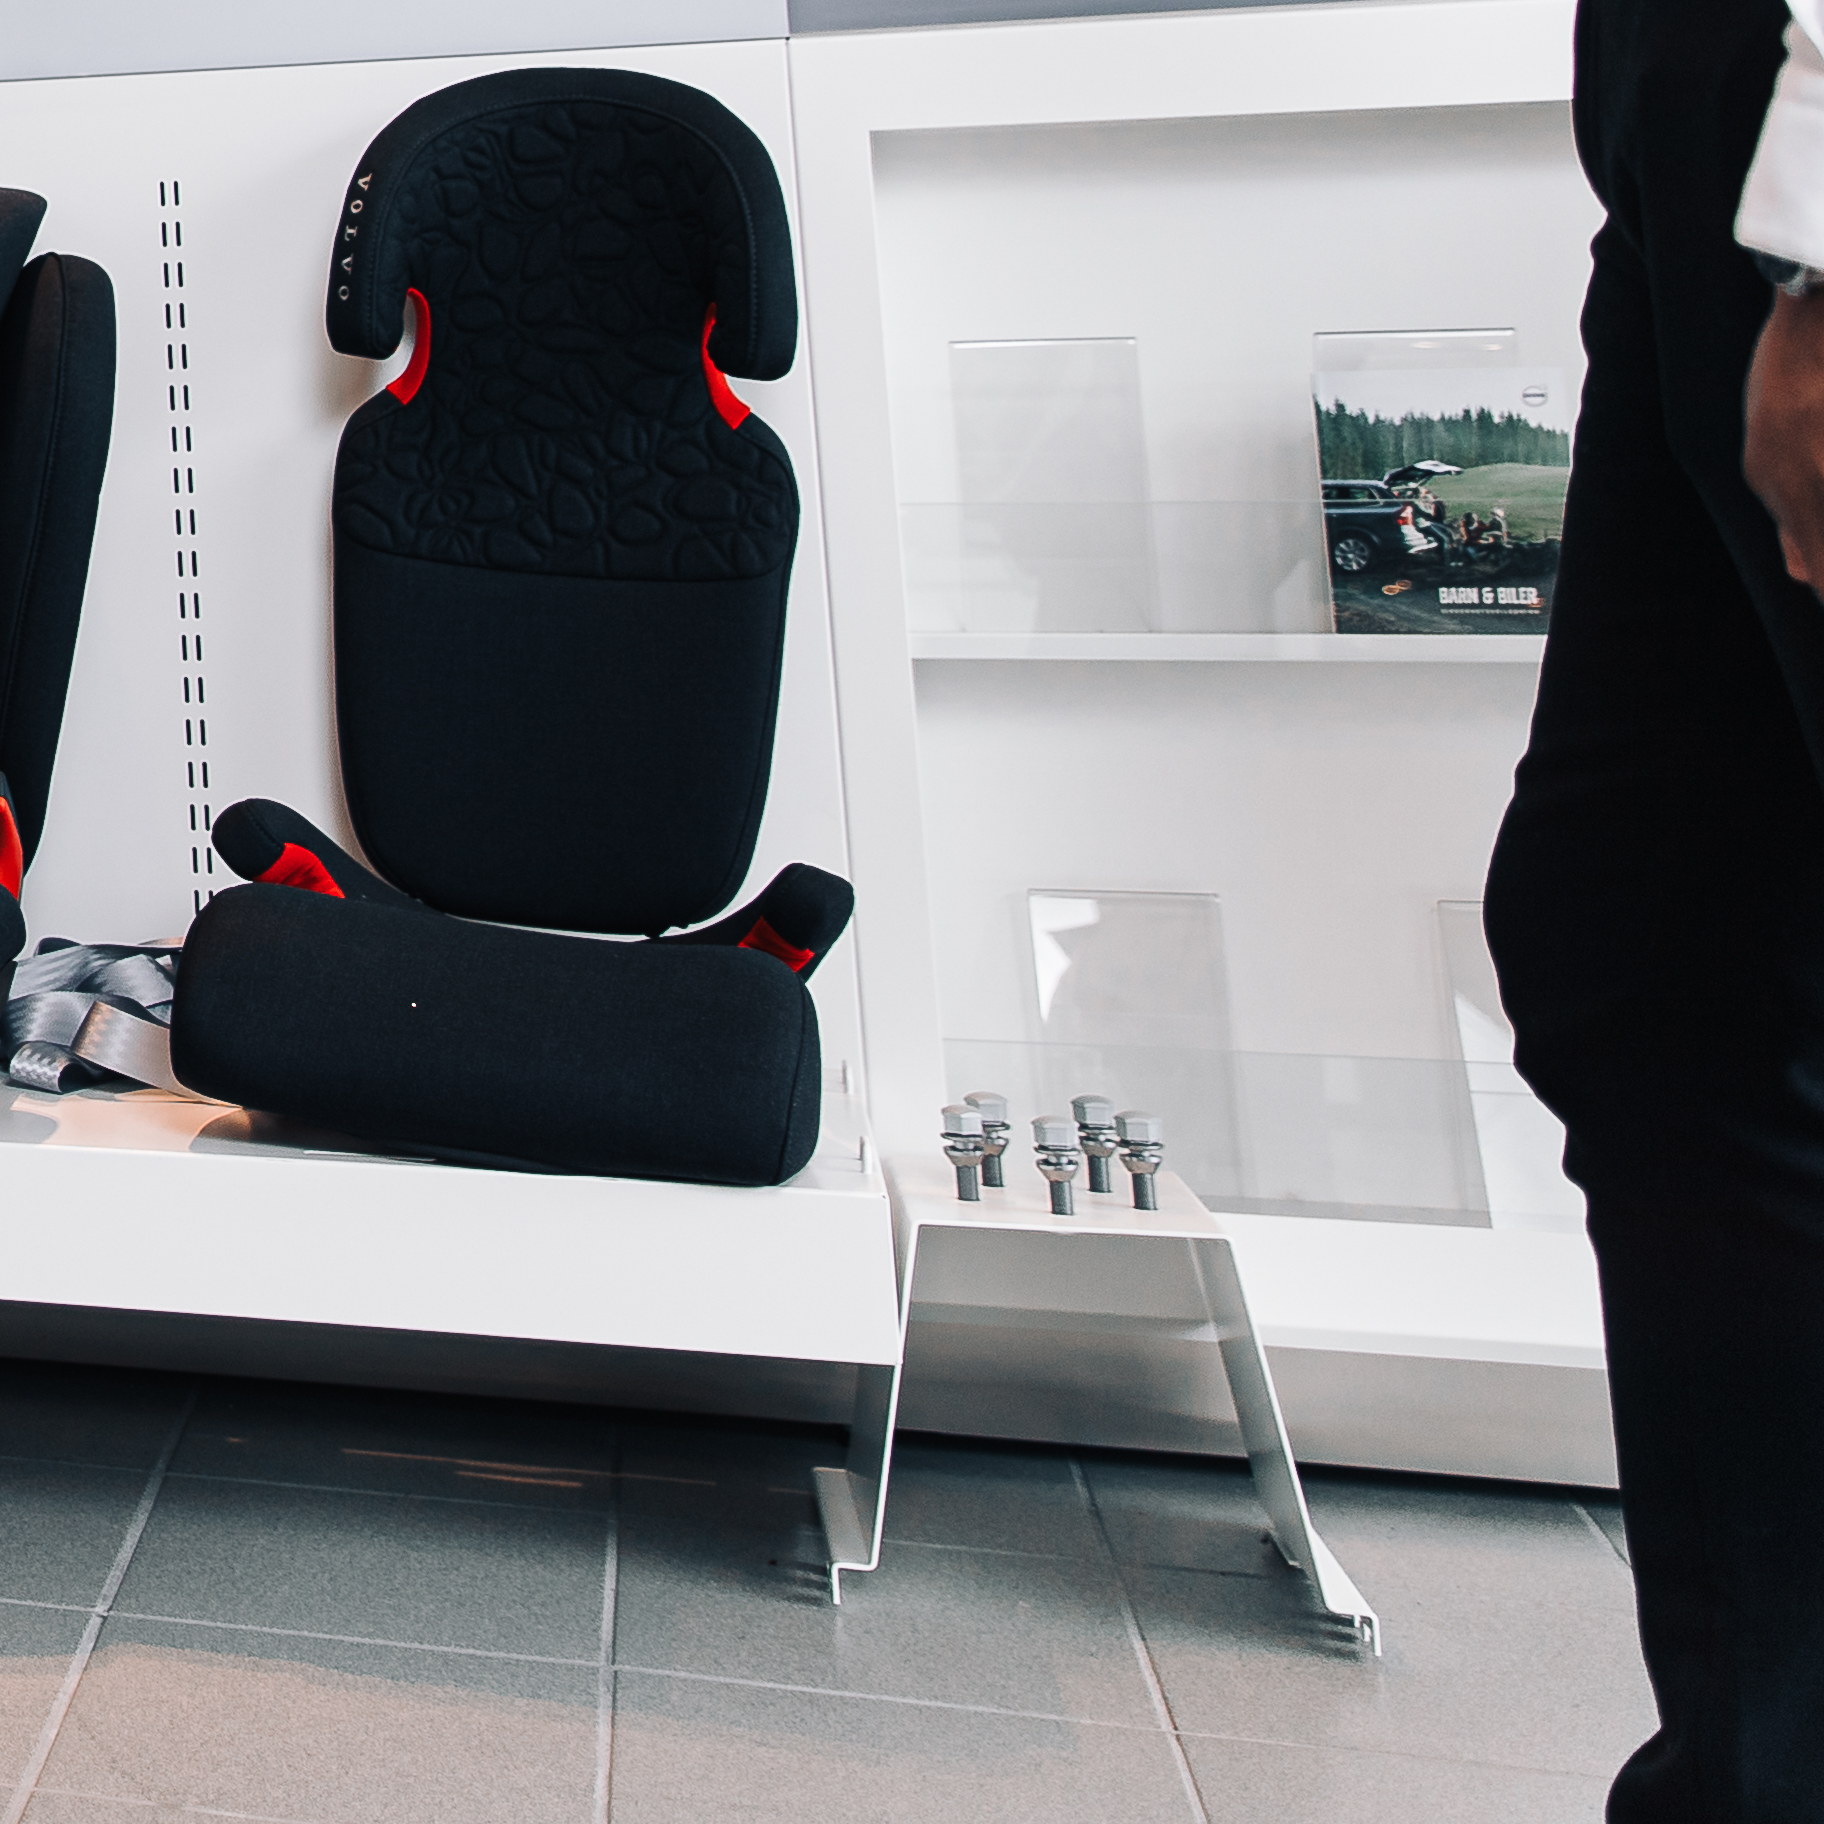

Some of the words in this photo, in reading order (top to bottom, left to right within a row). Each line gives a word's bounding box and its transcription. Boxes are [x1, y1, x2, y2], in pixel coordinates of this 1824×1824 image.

[337, 173, 373, 301] VOLVO
[1438, 587, 1480, 604] BARN
[1496, 587, 1539, 604] BILER
